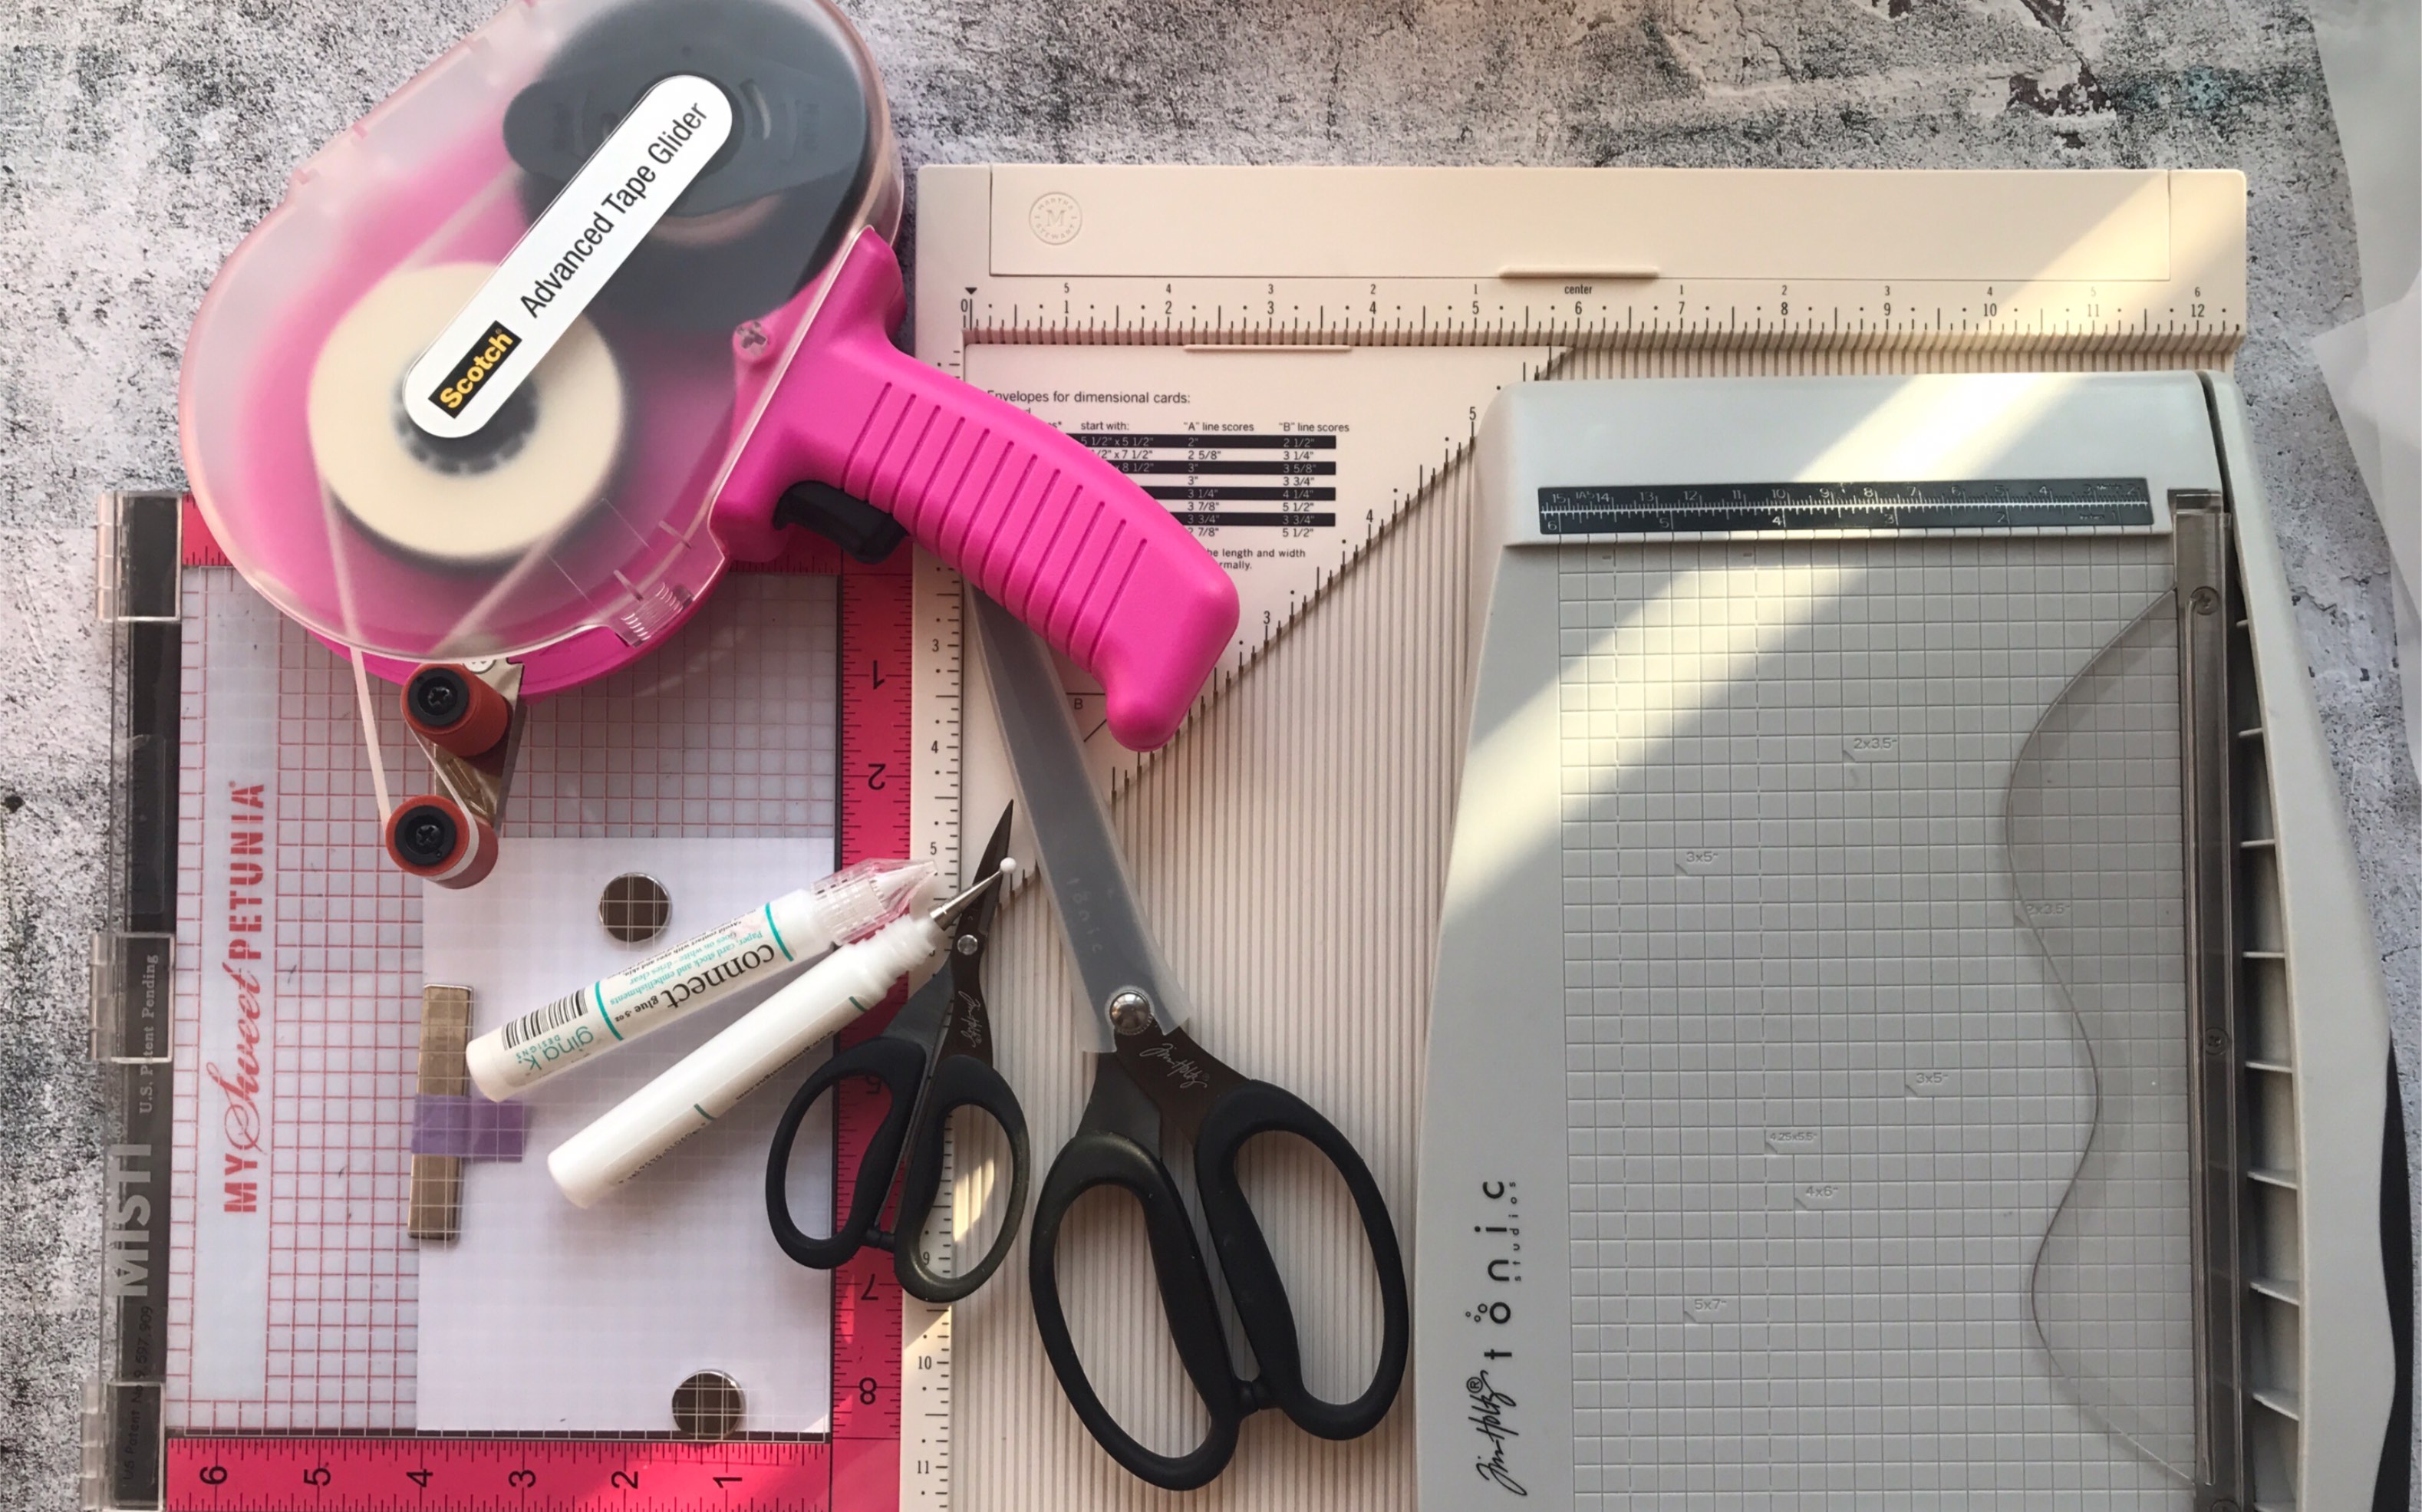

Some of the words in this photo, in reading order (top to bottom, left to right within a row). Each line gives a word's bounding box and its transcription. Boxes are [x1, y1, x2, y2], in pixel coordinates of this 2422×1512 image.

[520, 212, 615, 319] Advanced
[601, 165, 657, 215] Tape
[648, 102, 707, 165] Glider
[1064, 283, 1069, 293] 5
[1166, 284, 1171, 293] 4
[1268, 284, 1274, 294] 3
[1371, 284, 1376, 295] 2
[1475, 284, 1477, 294] 1
[1565, 283, 1592, 294] center
[1680, 285, 1683, 295] 1
[1782, 285, 1787, 295] 2
[1886, 286, 1890, 295] 3
[1988, 287, 1992, 295] 4
[2195, 287, 2200, 297] 6
[961, 298, 968, 312] 0
[1065, 301, 1069, 314] 1
[1165, 301, 1171, 315] 2
[1267, 301, 1274, 315] 3
[1369, 301, 1376, 314] 4
[1473, 301, 1479, 315] 5
[1575, 301, 1582, 318] 6
[1679, 301, 1685, 318] 7
[1781, 302, 1788, 319] 8
[1884, 303, 1890, 315] 9
[1984, 303, 1997, 316] 10
[2088, 304, 2099, 317] 11
[2192, 304, 2204, 317] 12
[1053, 390, 1069, 402] for
[1074, 392, 1149, 403] dimensional
[1153, 392, 1191, 404] cards:
[1469, 407, 1476, 420] 5
[1080, 421, 1103, 430] start
[1106, 421, 1129, 430] with:
[1184, 422, 1200, 431] "A"
[1203, 423, 1219, 431] line
[1279, 423, 1295, 431] "B"
[1298, 423, 1314, 431] line
[1081, 436, 1087, 445] 5
[1092, 436, 1112, 446] 1/2"
[1122, 436, 1129, 446] 5
[1133, 437, 1154, 446] 1/2"
[1283, 438, 1290, 447] 2
[1294, 438, 1314, 447] 1/2"
[1122, 450, 1128, 459] 7
[1132, 450, 1153, 459] 1/2"
[1188, 451, 1194, 460] 2
[1198, 451, 1221, 460] 5/8"
[1283, 451, 1289, 460] 3
[1293, 451, 1314, 460] 1/4"
[1122, 463, 1129, 472] 8
[1133, 463, 1154, 472] 1/2"
[1283, 464, 1289, 473] 3
[1293, 464, 1316, 473] 5/8"
[1283, 477, 1289, 486] 3
[1293, 477, 1314, 486] 3/4"
[1188, 489, 1194, 498] 3
[1198, 489, 1219, 498] 1/4"
[1283, 490, 1289, 499] 4
[1293, 490, 1314, 499] 1/4"
[1553, 493, 1566, 503] 15
[1596, 492, 1610, 502] 14
[1640, 492, 1654, 501] 13
[1684, 490, 1699, 500] 12
[1732, 490, 1742, 500] 11
[1771, 489, 1786, 499] 10
[1820, 488, 1829, 498] 9
[1863, 487, 1873, 497] 8
[1908, 487, 1916, 497] 7
[1188, 502, 1194, 511] 3
[1198, 502, 1219, 511] 7/8"
[1283, 502, 1289, 512] 5
[1293, 502, 1314, 512] 1/2"
[1188, 515, 1194, 524] 3
[1198, 515, 1219, 524] 3/4"
[1283, 516, 1289, 525] 3
[1293, 516, 1314, 525] 3/4"
[1366, 509, 1373, 522] 4
[1547, 521, 1557, 531] 6
[1659, 518, 1669, 528] 5
[1772, 516, 1782, 525] 4
[1883, 514, 1893, 524] 3
[1997, 512, 2007, 523] 2
[1198, 528, 1219, 536] 7/8"
[1283, 529, 1289, 537] 5
[1293, 529, 1314, 537] 1/2"
[1222, 548, 1253, 558] length
[1257, 549, 1274, 558] and
[1278, 549, 1305, 558] width
[1264, 611, 1270, 624] 3
[932, 638, 939, 652] 3
[1074, 698, 1082, 710] B
[931, 740, 938, 753] 4
[868, 763, 886, 790] 2
[930, 843, 937, 855] 5
[680, 947, 703, 960] white
[717, 944, 735, 957] card
[694, 953, 715, 967] stock
[651, 961, 672, 974] dries
[677, 964, 691, 977] and
[630, 972, 650, 984] clear
[661, 944, 775, 1009] connect
[141, 954, 158, 1017] Pending
[610, 971, 675, 1005] embellishments
[634, 996, 659, 1013] glue
[140, 1026, 153, 1075] Ptent
[516, 1035, 561, 1059] DESIGNS
[542, 1026, 598, 1067] gina
[206, 960, 268, 1155] Sweet
[139, 1082, 153, 1113] U.S.
[223, 1153, 258, 1213] MY
[106, 1143, 152, 1297] MISTI
[1508, 1181, 1521, 1282] studios
[923, 1251, 930, 1265] 9
[1475, 1181, 1512, 1360] tonic
[861, 1273, 878, 1300] 7
[918, 1356, 931, 1370] 10
[858, 1377, 877, 1405] 8
[917, 1461, 929, 1474] 11
[199, 1466, 228, 1485] 6
[303, 1468, 331, 1486] 5
[406, 1468, 433, 1487] 4
[508, 1470, 535, 1487] 3
[611, 1471, 638, 1489] 2
[713, 1477, 743, 1488] 1
